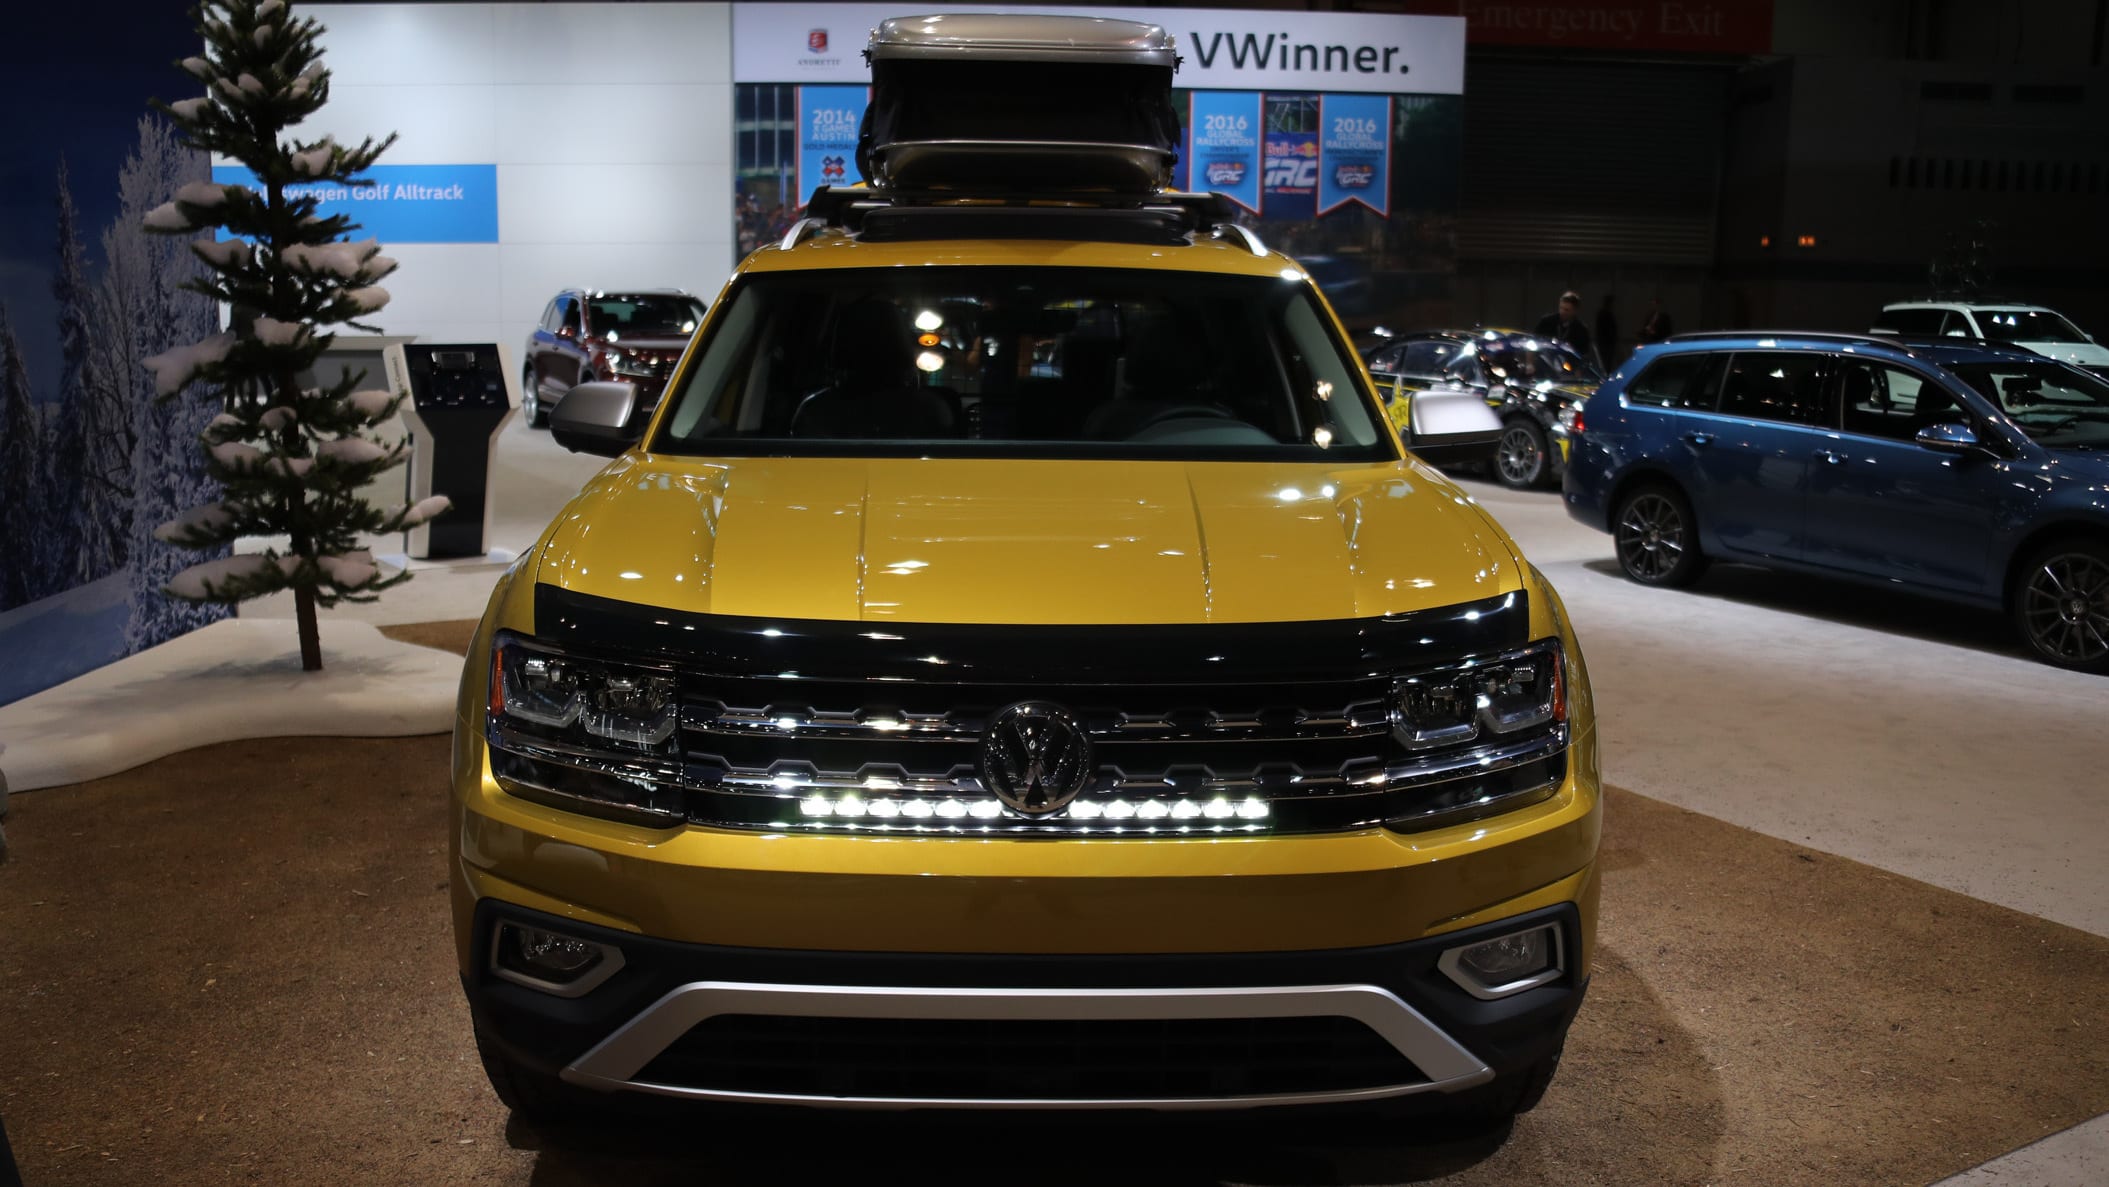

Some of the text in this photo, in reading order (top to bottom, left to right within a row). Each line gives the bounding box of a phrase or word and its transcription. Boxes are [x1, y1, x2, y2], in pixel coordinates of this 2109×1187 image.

[1458, 0, 1725, 40] Emergency Exit
[1189, 31, 1410, 75] VWinner.
[812, 109, 857, 124] 2014
[1204, 114, 1249, 130] 2016
[1333, 117, 1377, 133] 2016
[812, 132, 857, 141] AUSTIN
[1265, 141, 1290, 156] Bull
[351, 184, 390, 201] Golf
[393, 184, 465, 201] Alltrack
